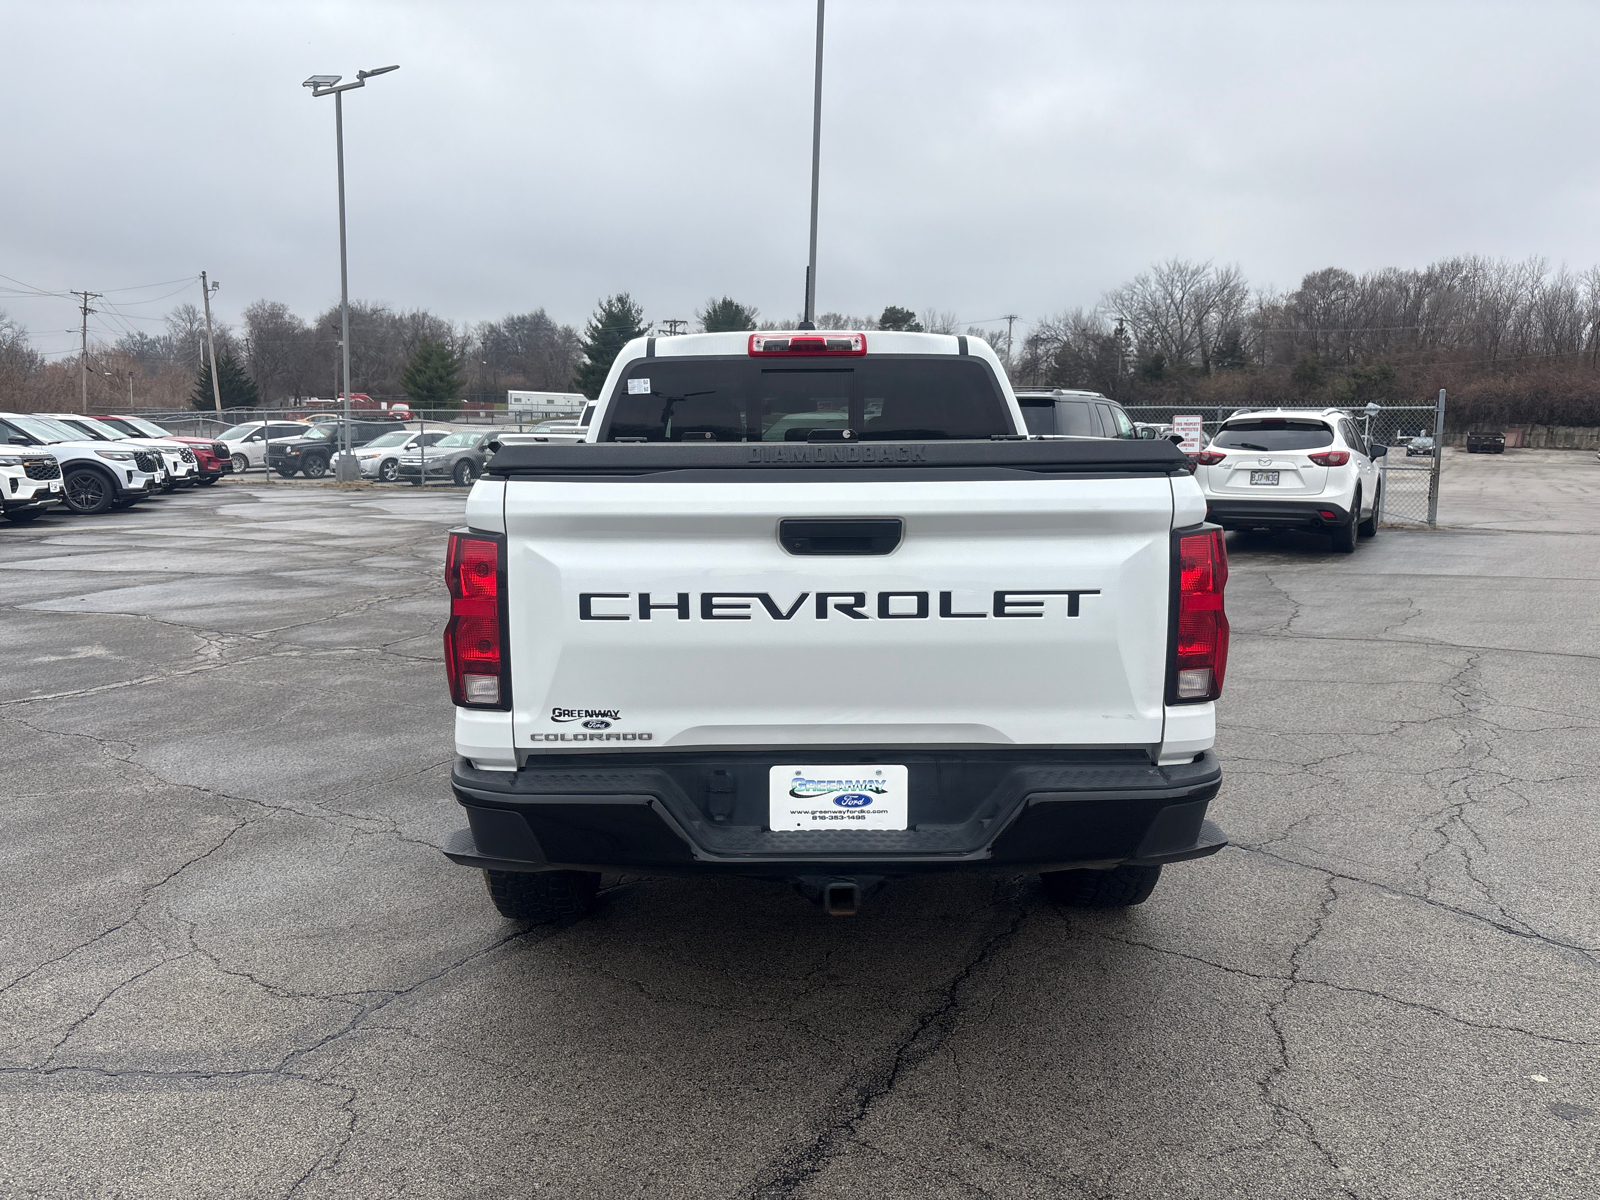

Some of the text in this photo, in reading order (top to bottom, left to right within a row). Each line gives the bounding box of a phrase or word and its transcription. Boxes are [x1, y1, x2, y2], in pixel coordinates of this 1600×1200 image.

[748, 445, 927, 464] DIAMONDBACK
[578, 589, 1101, 621] CHEVROLET
[552, 707, 620, 719] GREENWAY
[530, 732, 653, 741] COLORADO
[791, 777, 887, 792] GREENWAY
